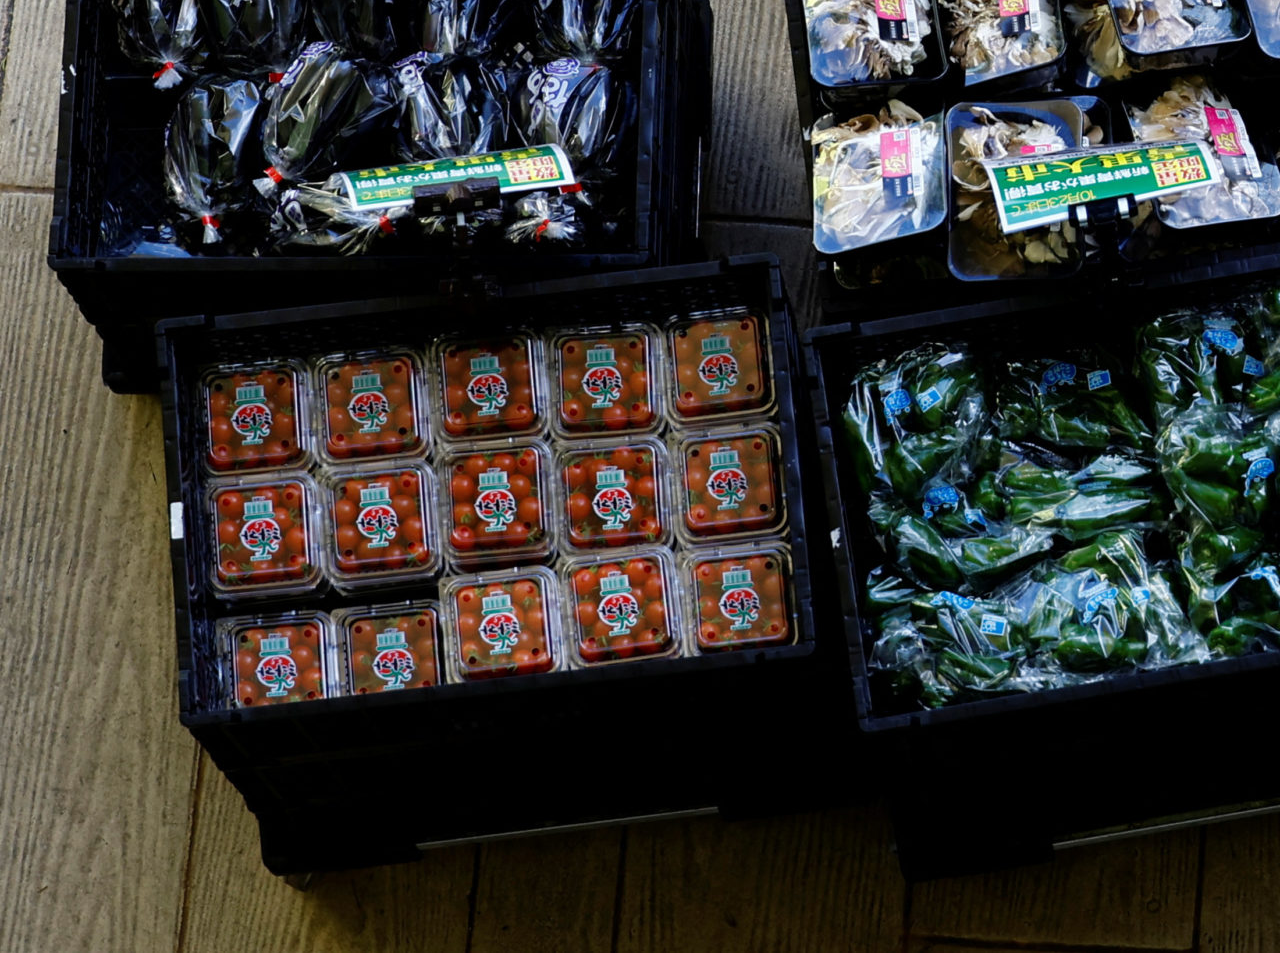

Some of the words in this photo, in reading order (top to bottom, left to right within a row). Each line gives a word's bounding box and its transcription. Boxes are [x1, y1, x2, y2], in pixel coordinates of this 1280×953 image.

[1004, 166, 1149, 200] 新鮮青果がお買得!
[1011, 189, 1096, 217] 10月23日まで
